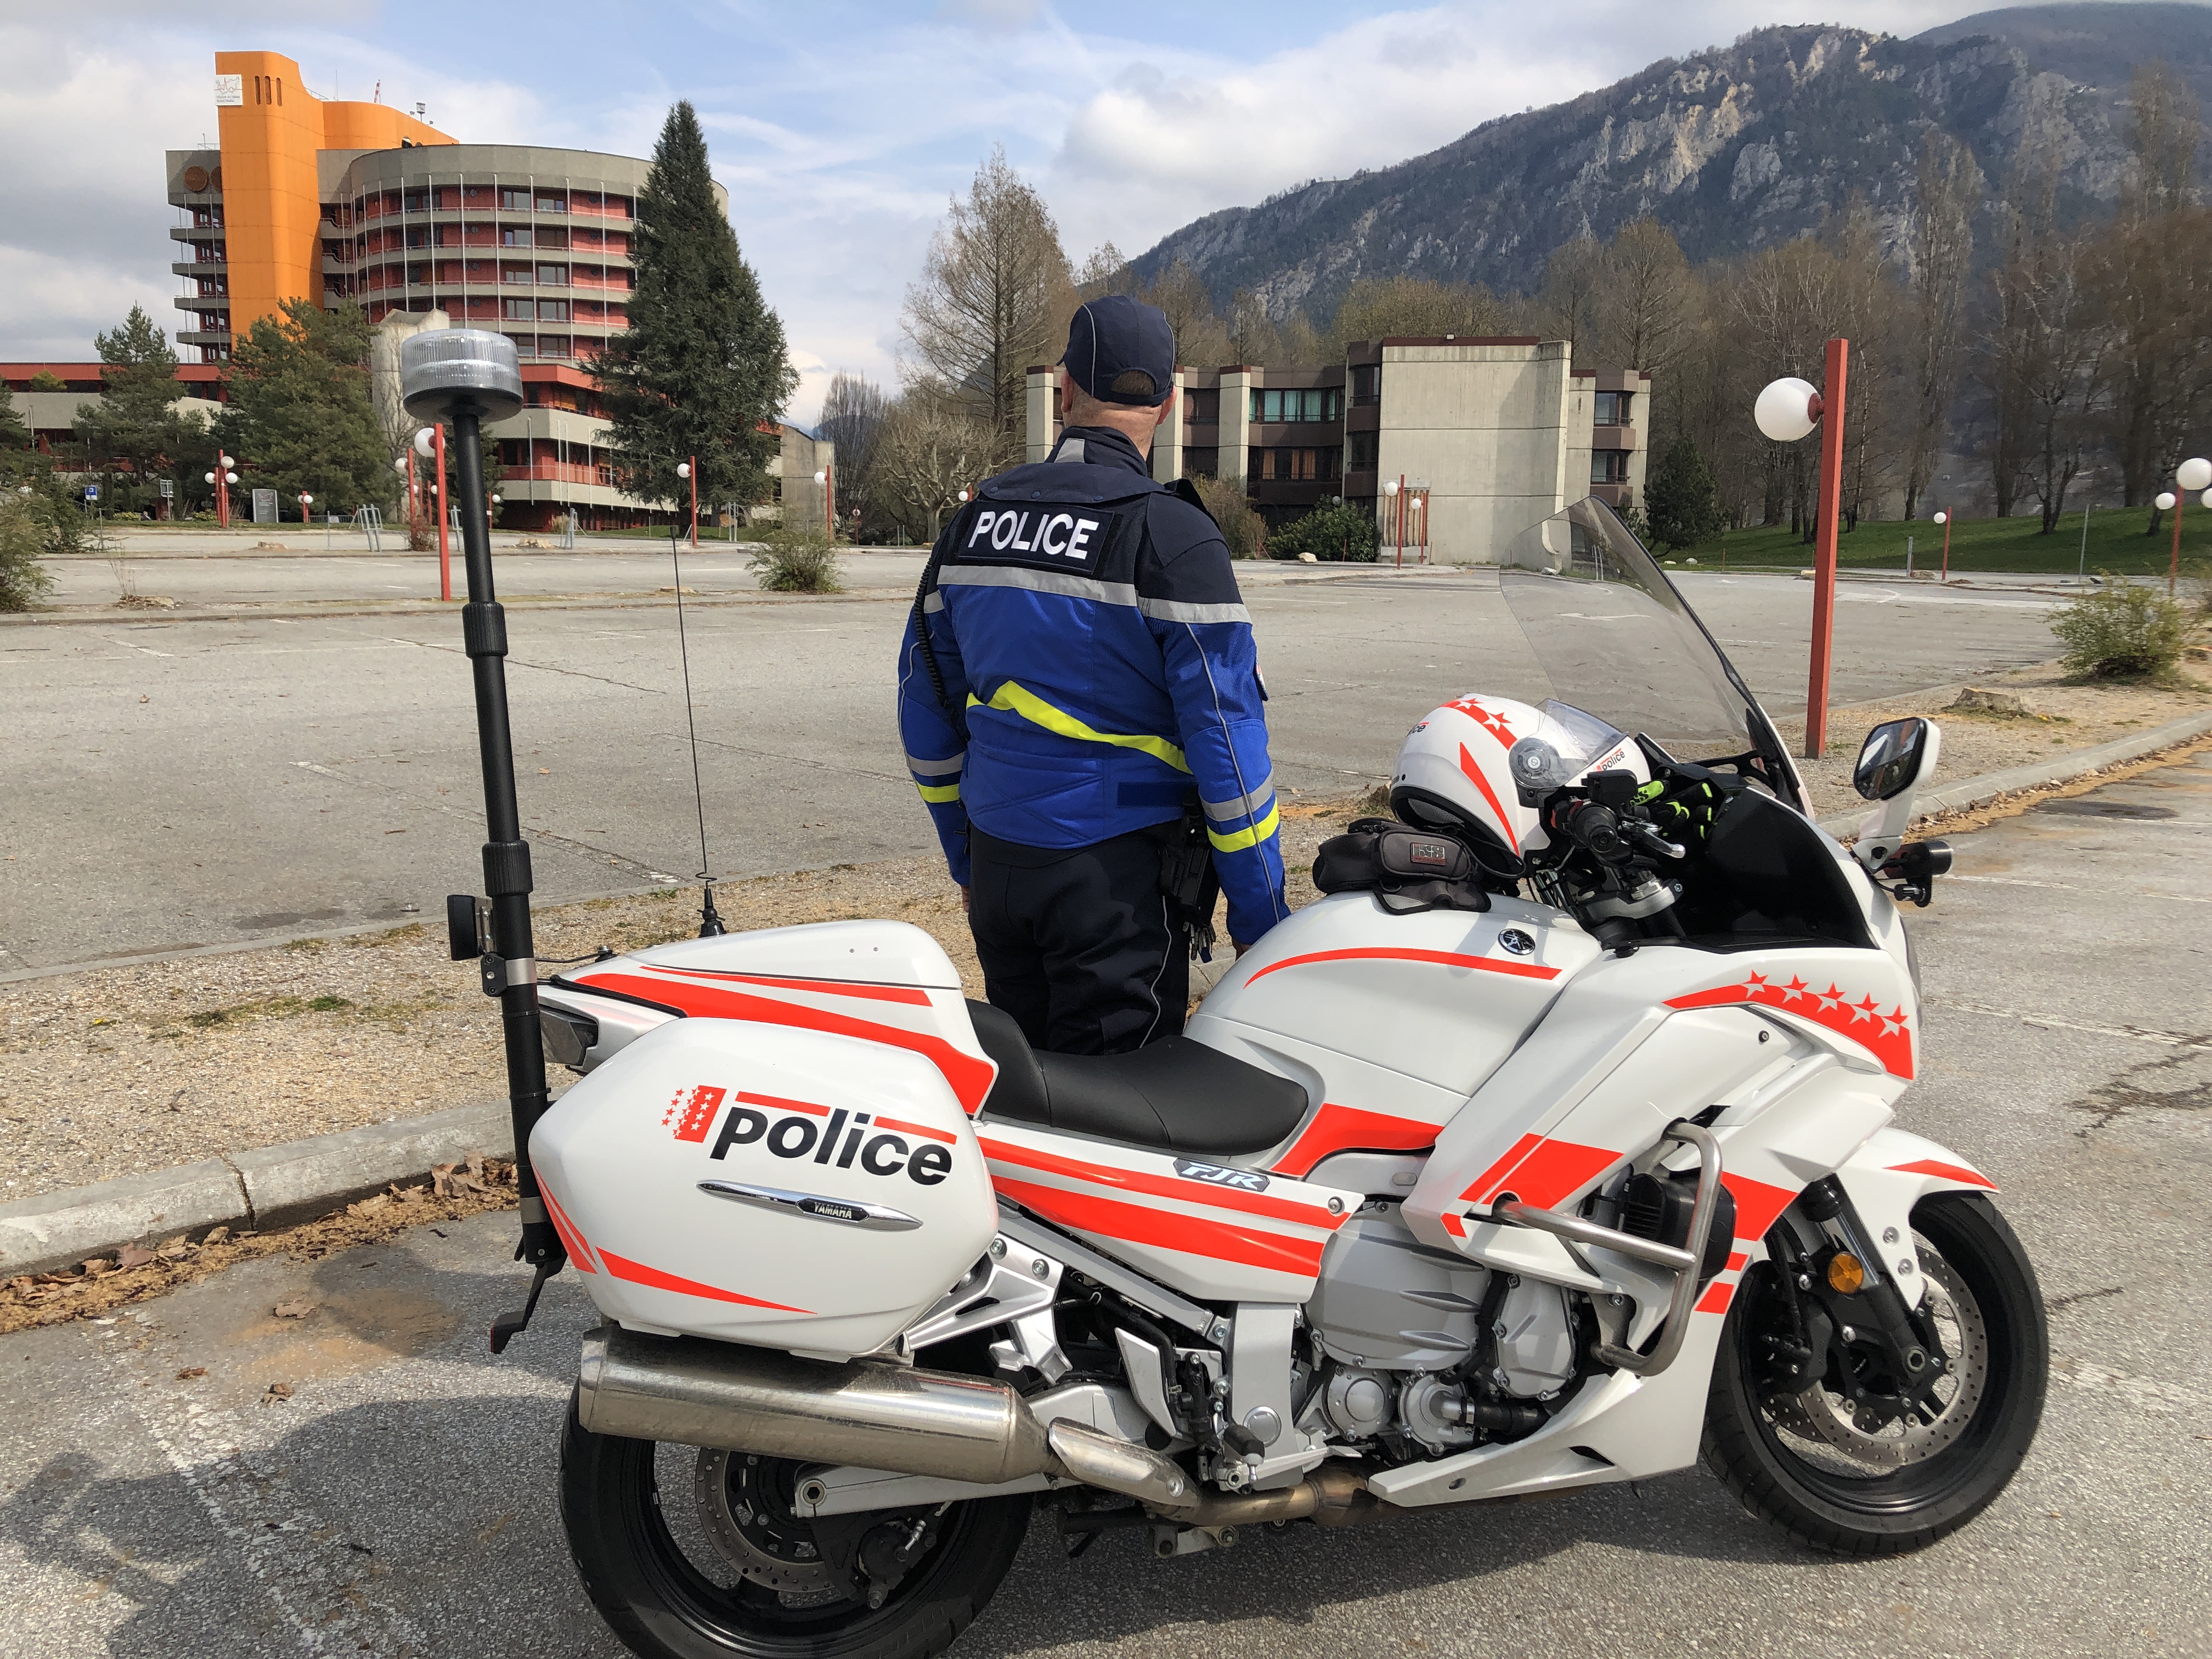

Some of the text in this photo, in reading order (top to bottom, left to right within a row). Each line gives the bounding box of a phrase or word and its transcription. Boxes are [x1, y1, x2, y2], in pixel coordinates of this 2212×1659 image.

[968, 511, 1099, 560] POLICE
[1602, 751, 1625, 771] police
[709, 1107, 952, 1186] police
[1181, 1161, 1263, 1190] FJR
[814, 1202, 852, 1218] YAMAHA
